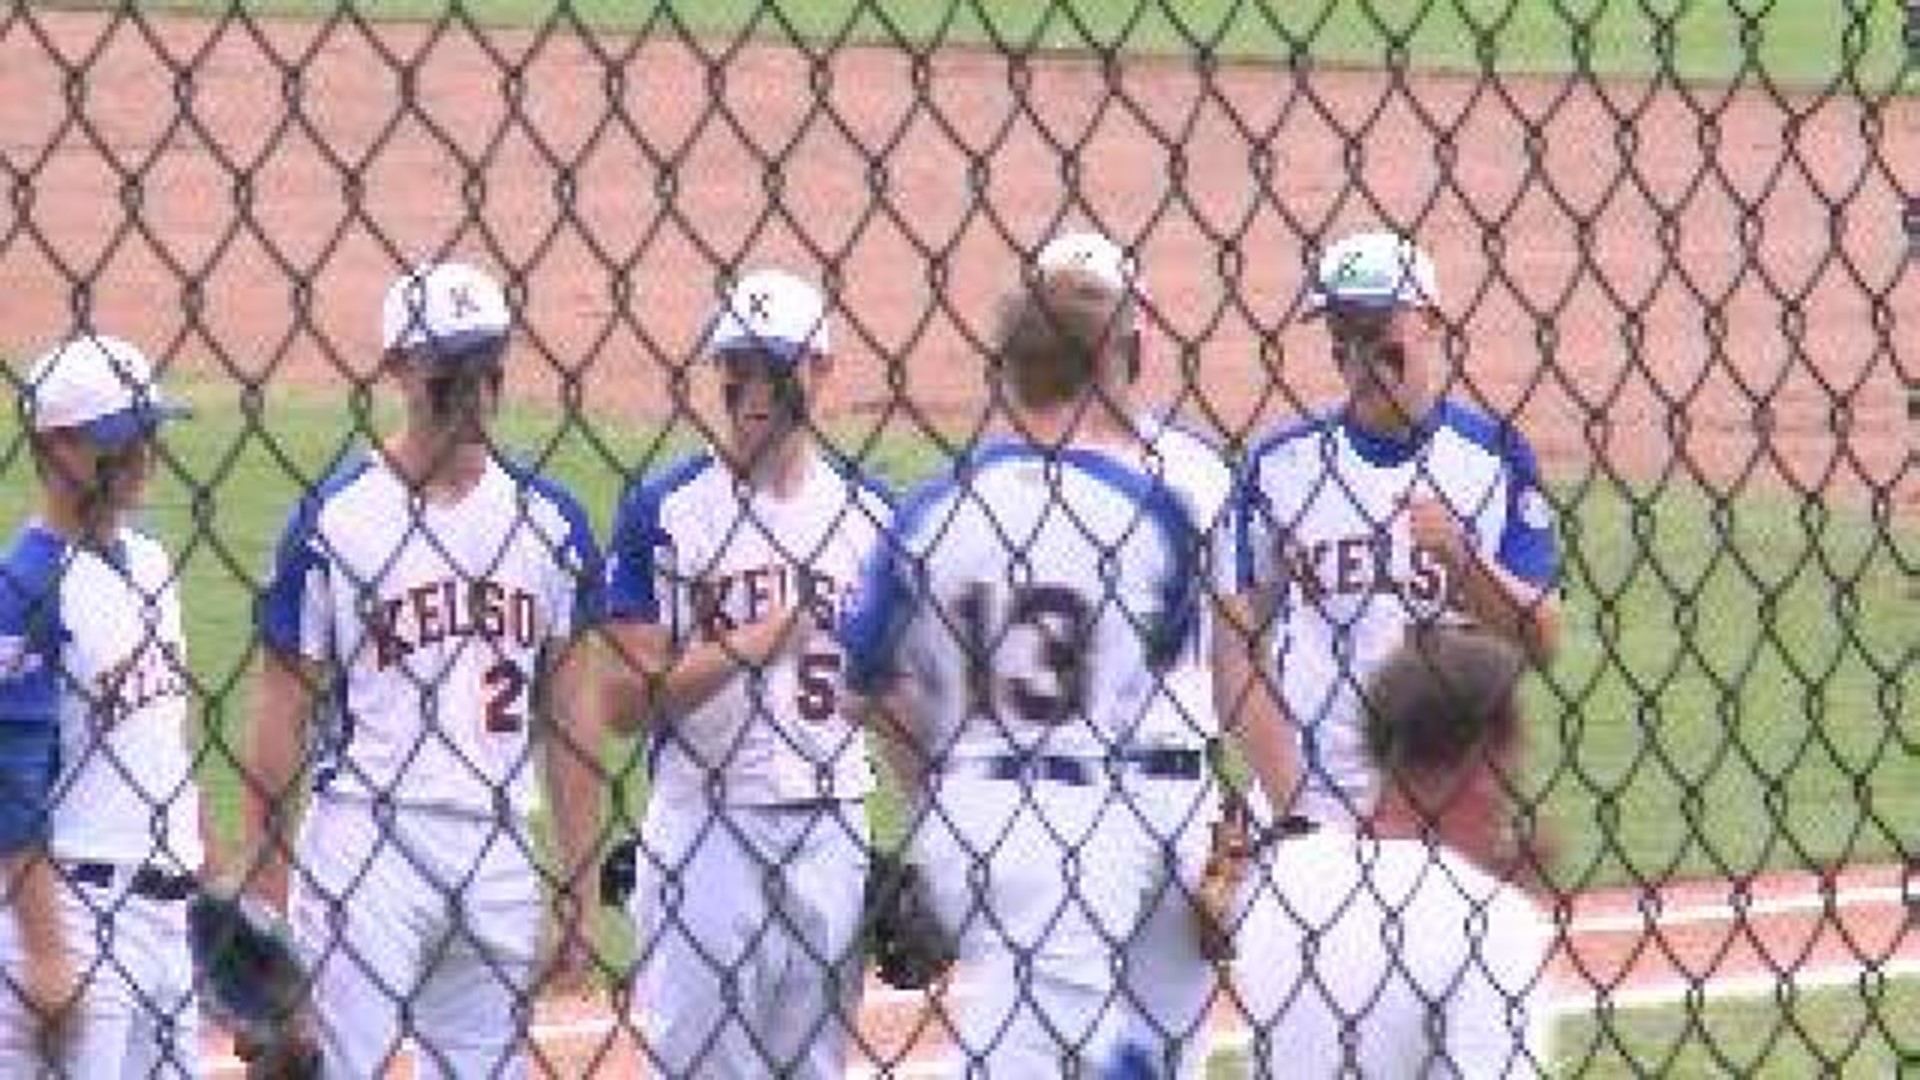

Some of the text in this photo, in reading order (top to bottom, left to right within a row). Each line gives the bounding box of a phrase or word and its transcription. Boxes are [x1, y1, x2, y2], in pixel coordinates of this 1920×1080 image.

[749, 292, 770, 319] K
[374, 580, 537, 672] KELSO
[952, 580, 1090, 726] 13
[486, 660, 526, 732] 2
[798, 653, 840, 721] 5
